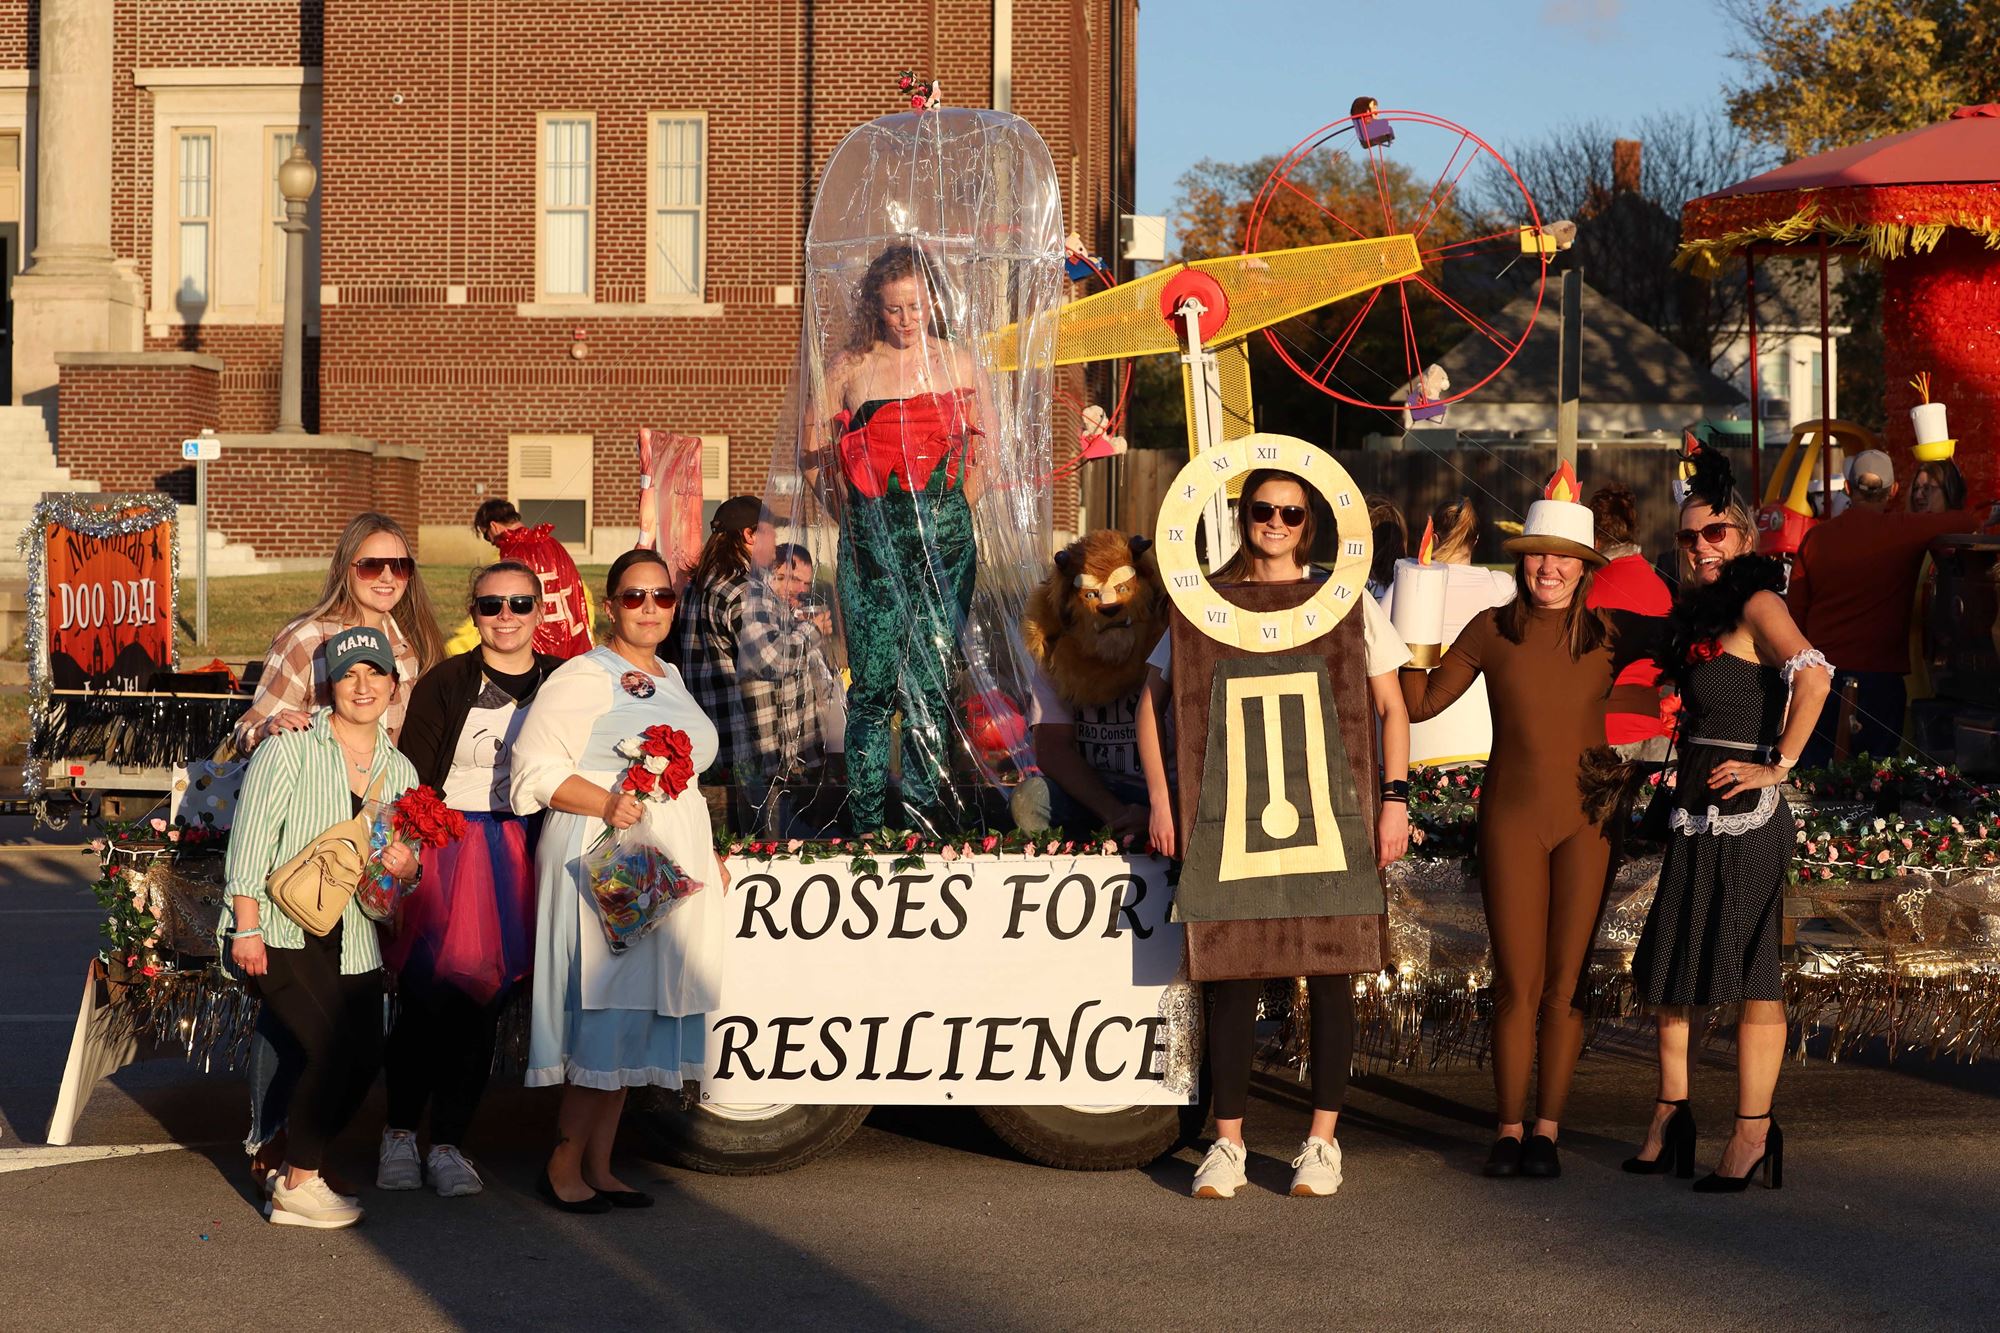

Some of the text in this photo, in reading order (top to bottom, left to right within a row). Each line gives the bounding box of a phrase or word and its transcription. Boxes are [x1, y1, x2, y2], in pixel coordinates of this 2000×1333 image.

[1257, 447, 1277, 460] XII
[1212, 457, 1230, 472] XI
[1304, 455, 1312, 467] I
[1183, 485, 1196, 498] X
[1339, 494, 1351, 506] II
[1168, 529, 1183, 541] IX
[1347, 543, 1363, 555] III
[1173, 575, 1199, 588] VIII
[1333, 585, 1351, 599] IV
[58, 578, 156, 630] DOO DAH
[1207, 611, 1227, 624] VII
[1305, 615, 1316, 626] V
[1262, 627, 1277, 639] VI
[336, 634, 379, 657] MAMA
[1078, 724, 1098, 739] R&D
[735, 873, 1154, 940] ROSES FOR
[712, 999, 1167, 1082] RESILIENCE
